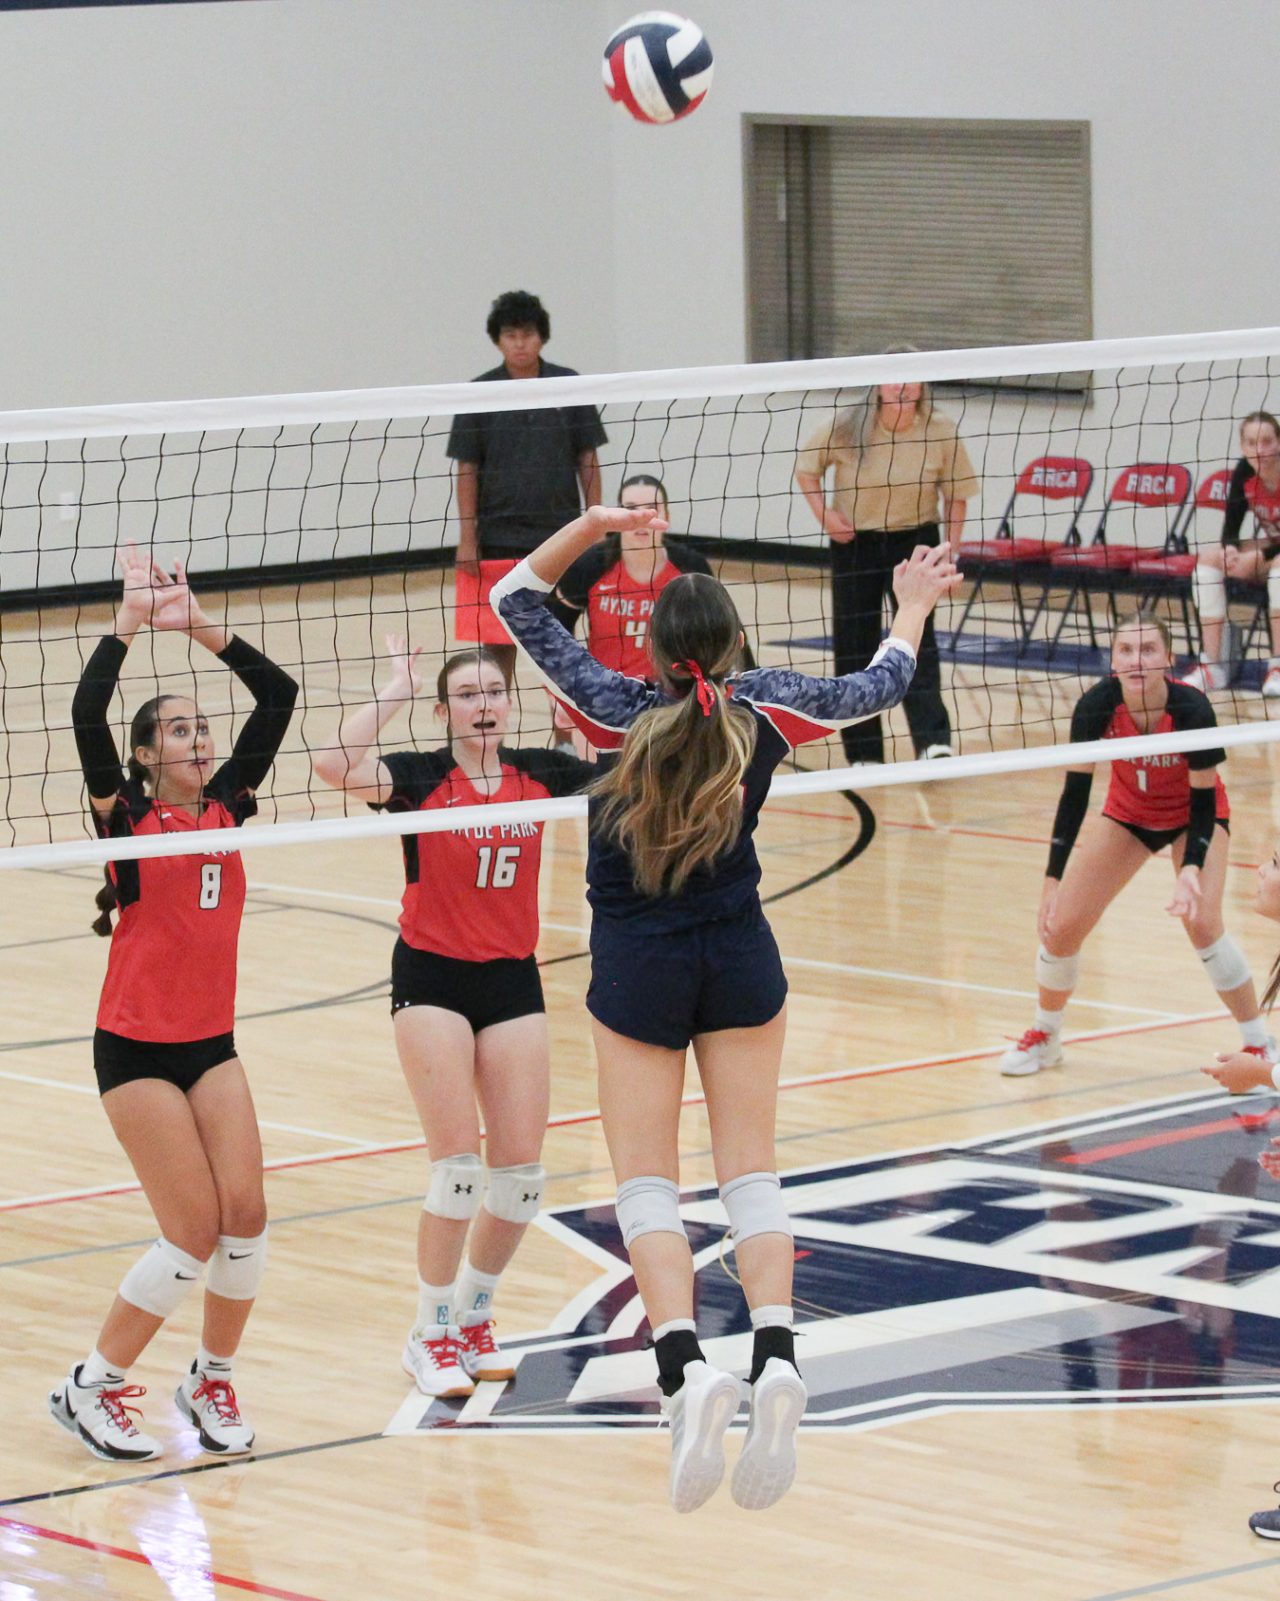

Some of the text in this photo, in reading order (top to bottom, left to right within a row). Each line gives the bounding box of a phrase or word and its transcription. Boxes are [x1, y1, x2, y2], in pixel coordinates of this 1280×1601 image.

[599, 595, 634, 616] HYDE
[626, 621, 646, 648] 4
[1142, 754, 1180, 768] PARK
[1135, 769, 1148, 793] 1
[474, 844, 522, 890] 16
[199, 864, 222, 909] 8
